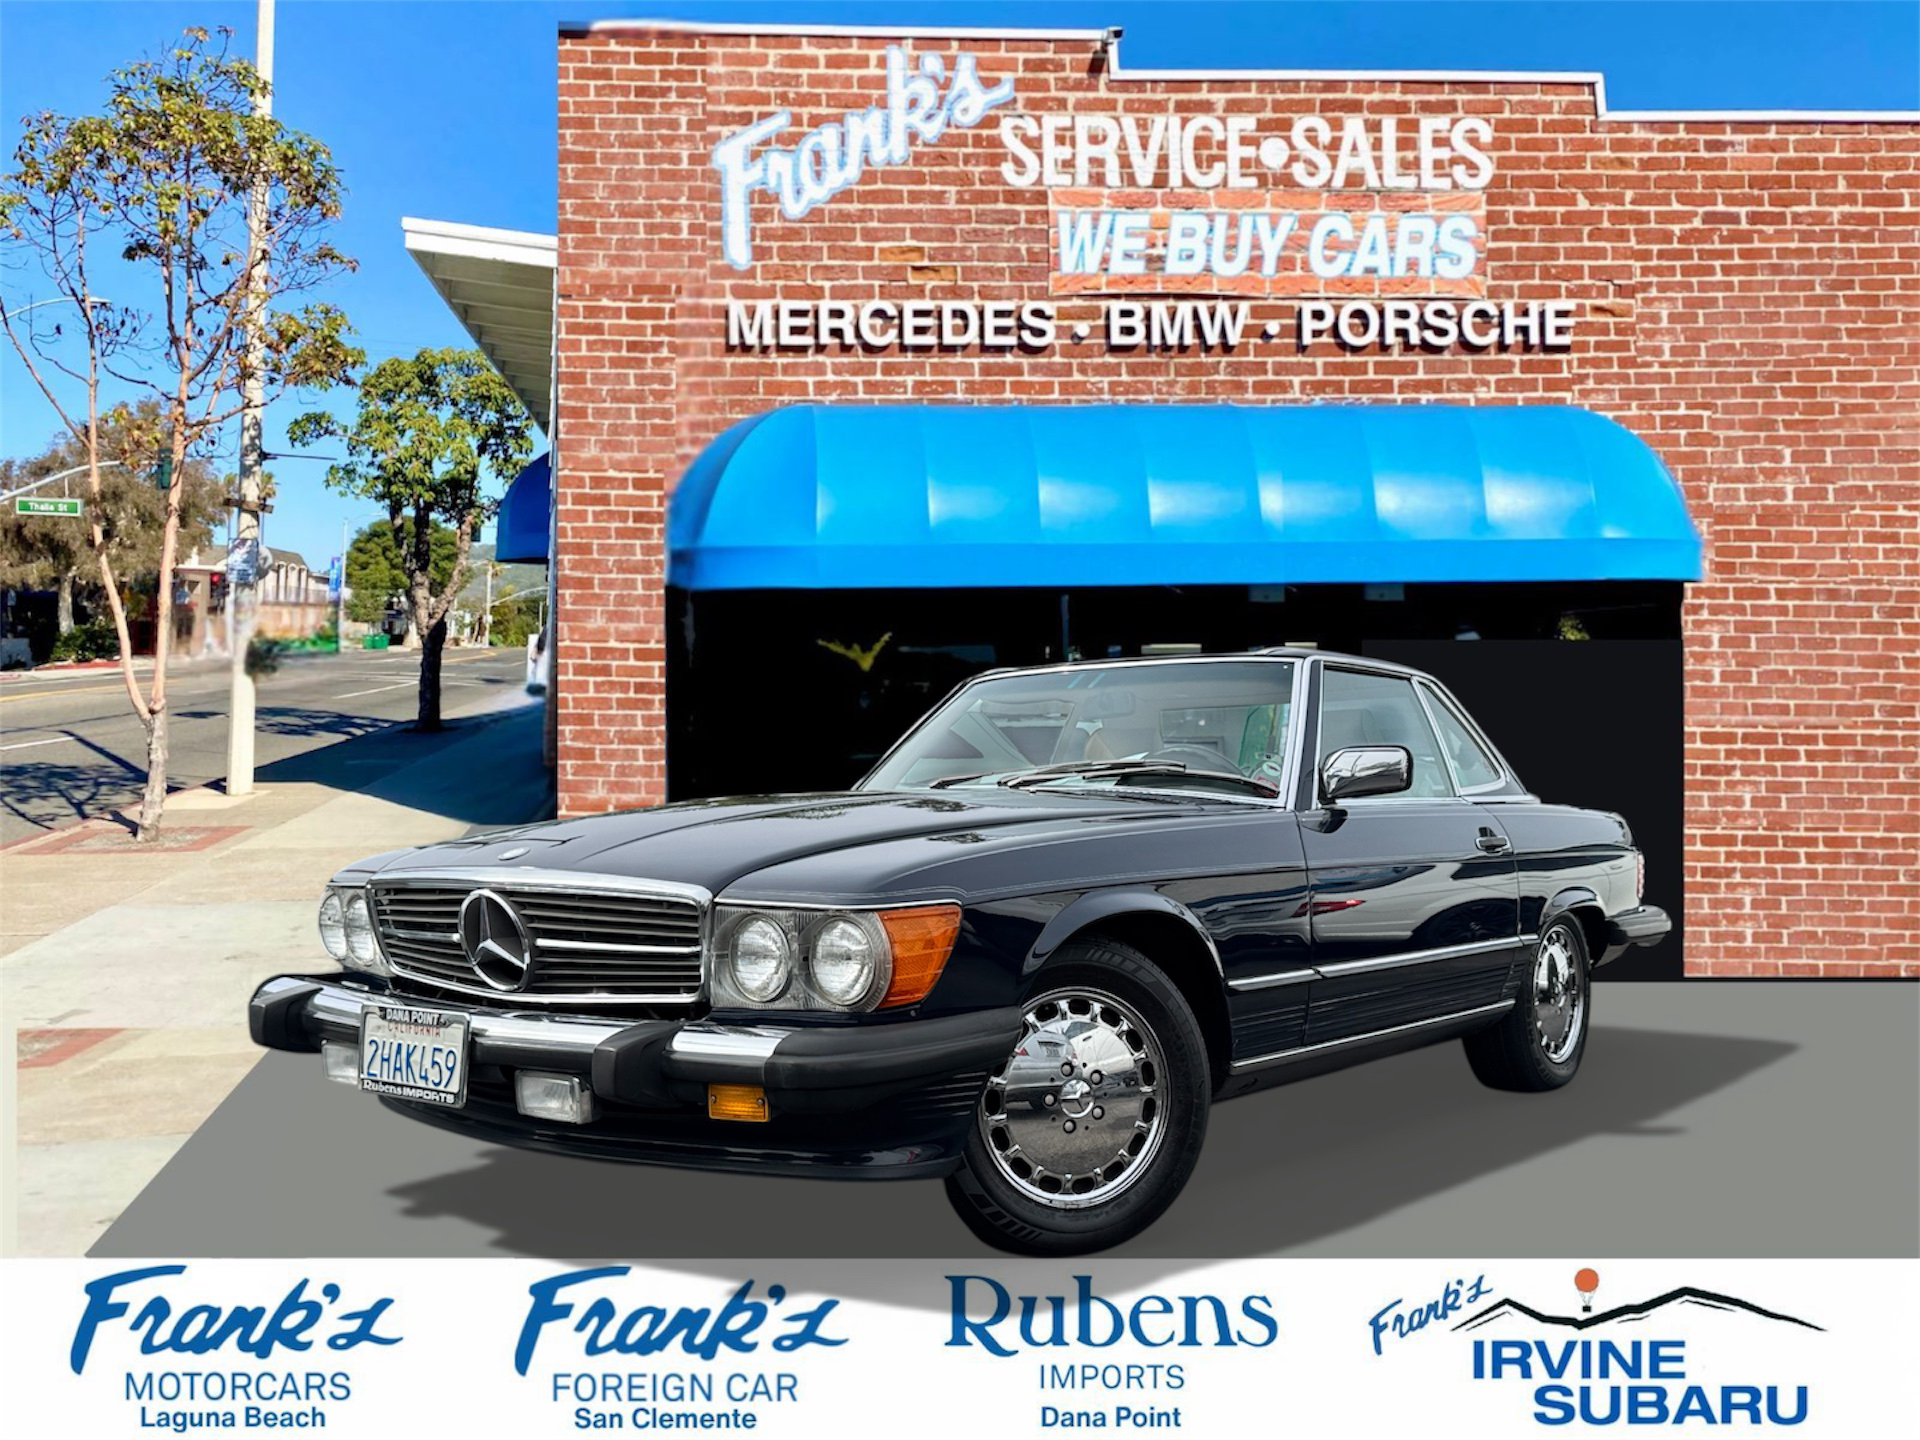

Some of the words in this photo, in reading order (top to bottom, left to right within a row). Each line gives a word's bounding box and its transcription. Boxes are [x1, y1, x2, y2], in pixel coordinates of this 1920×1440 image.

[713, 46, 1016, 270] Frank's
[1055, 210, 1148, 275] WE
[1165, 211, 1295, 276] BUY
[1308, 212, 1478, 278] CARS
[727, 301, 1056, 348] MERCEDES
[1108, 303, 1249, 346] BMW
[1299, 301, 1575, 347] PORSCHE
[57, 503, 68, 511] St
[386, 1008, 410, 1023] DANA
[411, 1011, 439, 1026] POINT
[388, 1023, 441, 1037] CALIFORNIA
[366, 1039, 457, 1089] 2HAK459
[363, 1079, 402, 1096] Rubens
[402, 1088, 454, 1103] IMPORTS
